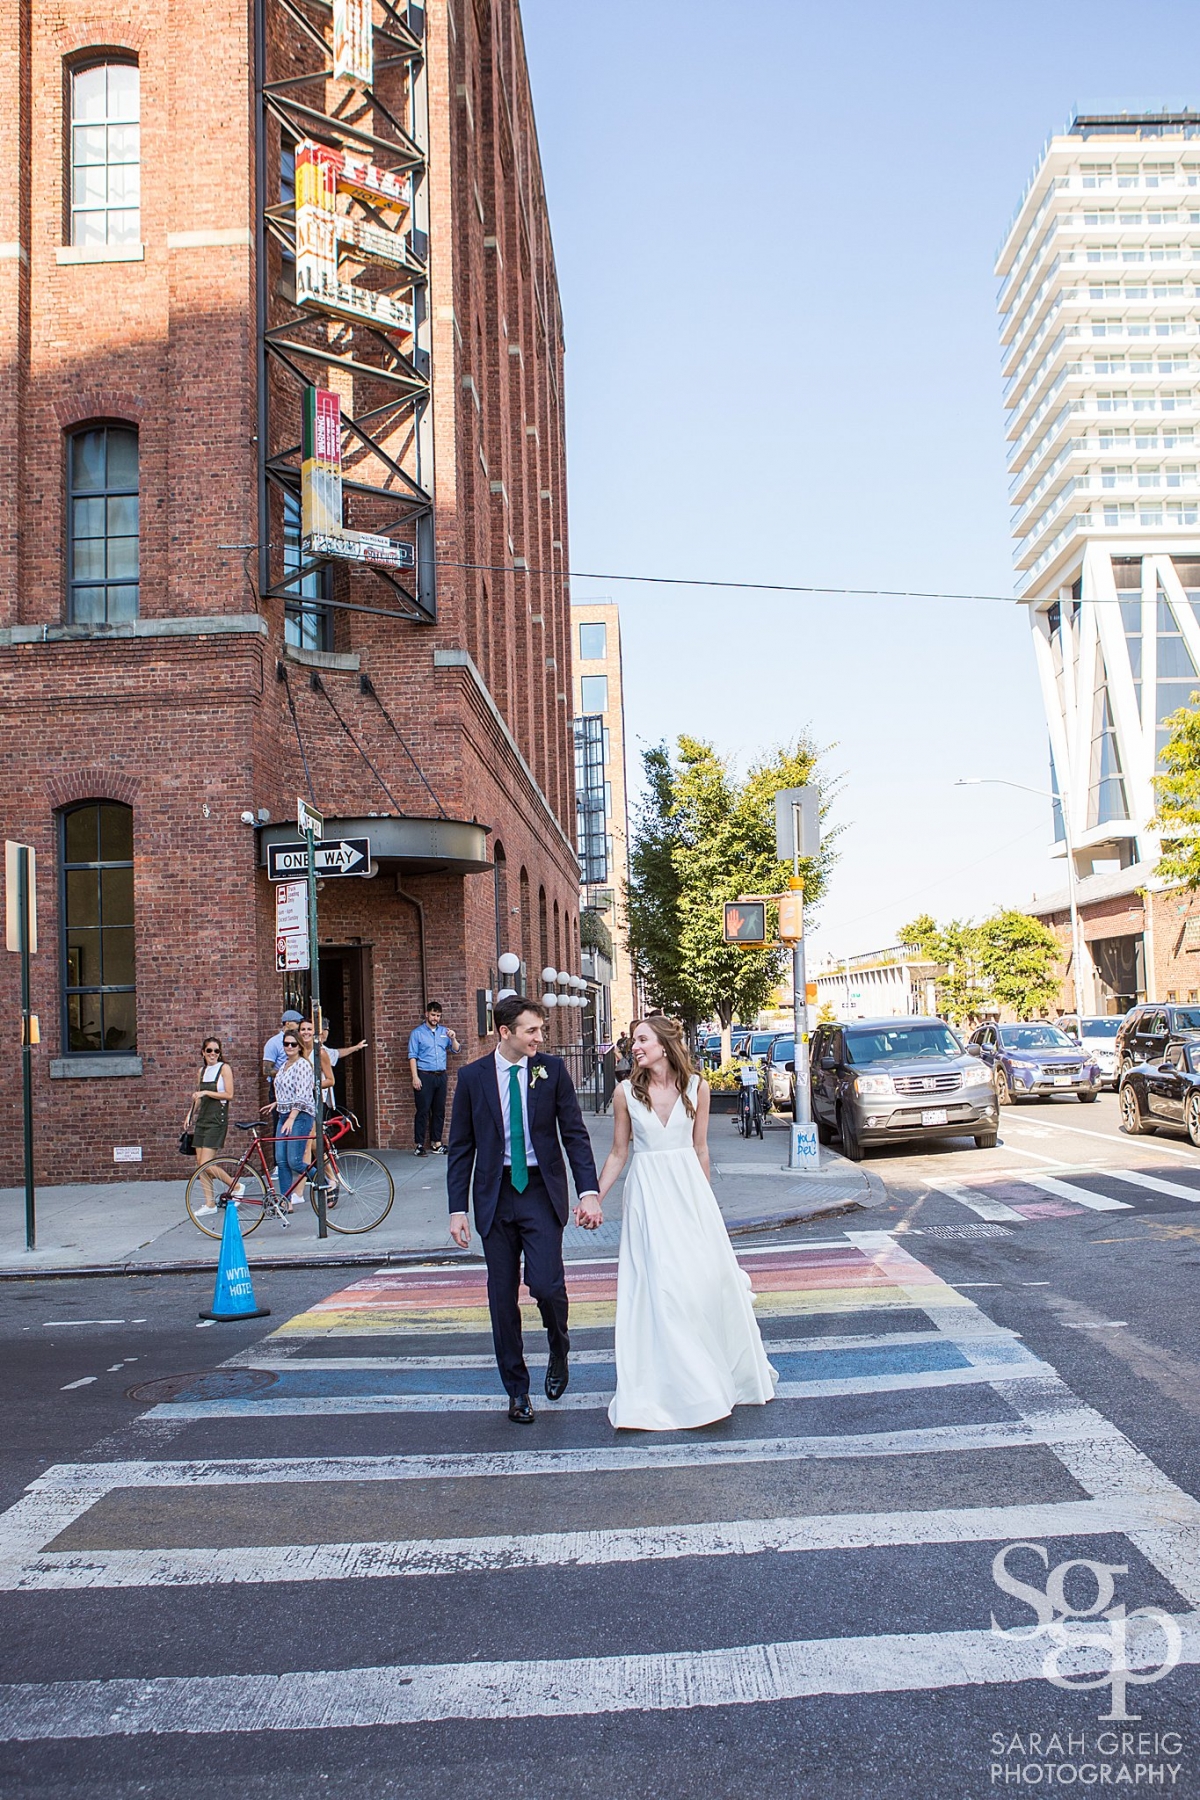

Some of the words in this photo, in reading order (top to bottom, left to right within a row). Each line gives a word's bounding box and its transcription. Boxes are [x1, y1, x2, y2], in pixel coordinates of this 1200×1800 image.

[352, 189, 379, 203] HOT
[384, 201, 393, 209] &
[317, 416, 325, 454] WARNING
[283, 854, 309, 868] ONE
[324, 850, 354, 866] WAY
